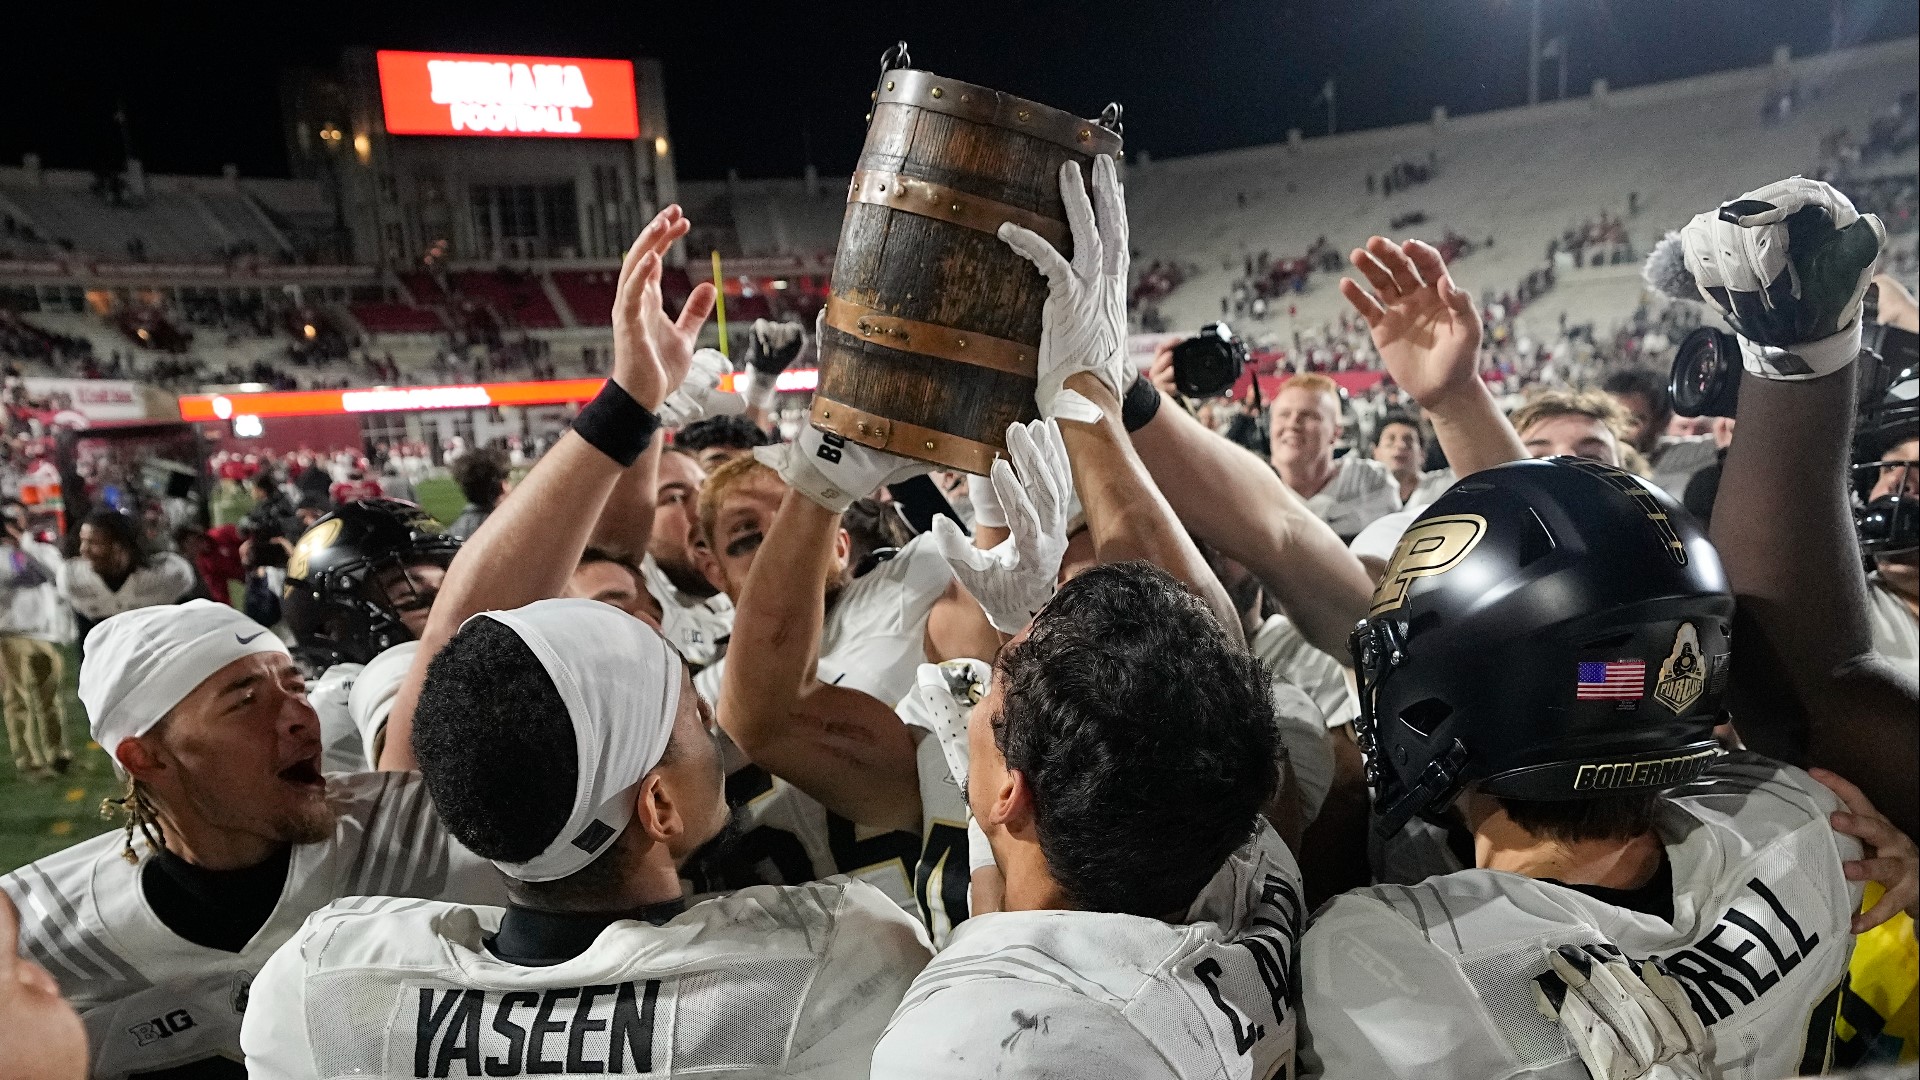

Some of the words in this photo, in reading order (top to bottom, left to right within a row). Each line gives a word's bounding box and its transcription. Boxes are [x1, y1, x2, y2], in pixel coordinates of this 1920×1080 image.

[450, 101, 581, 133] FOOTBALL
[1367, 513, 1488, 613] P
[1660, 677, 1702, 702] PURDUE
[414, 979, 661, 1079] YASEEN
